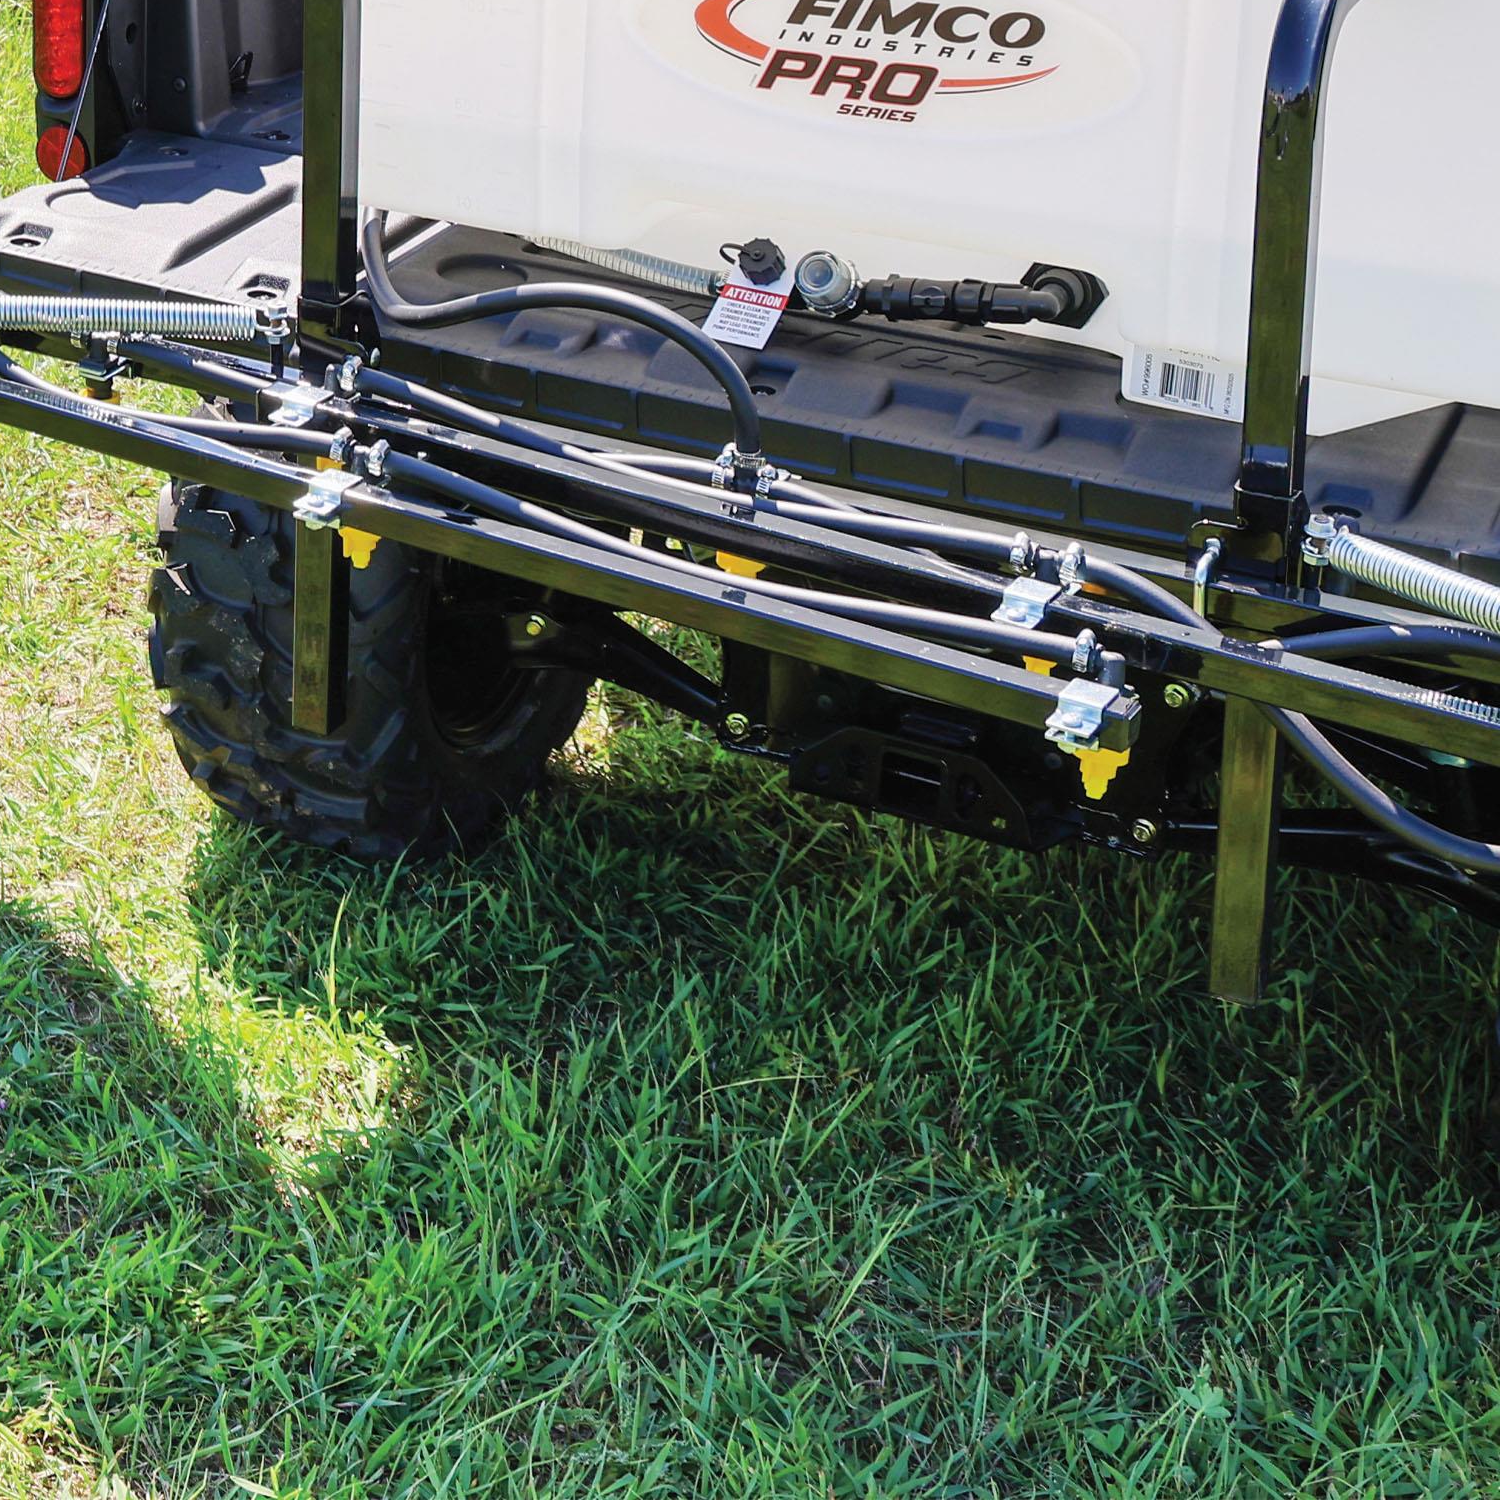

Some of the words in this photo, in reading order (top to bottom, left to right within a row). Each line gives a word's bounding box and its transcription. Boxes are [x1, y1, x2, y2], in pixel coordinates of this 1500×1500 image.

[778, 29, 1035, 67] INDUSTRIES
[756, 50, 940, 106] PRO
[836, 104, 918, 123] SERIES
[725, 287, 782, 308] ATTENTION
